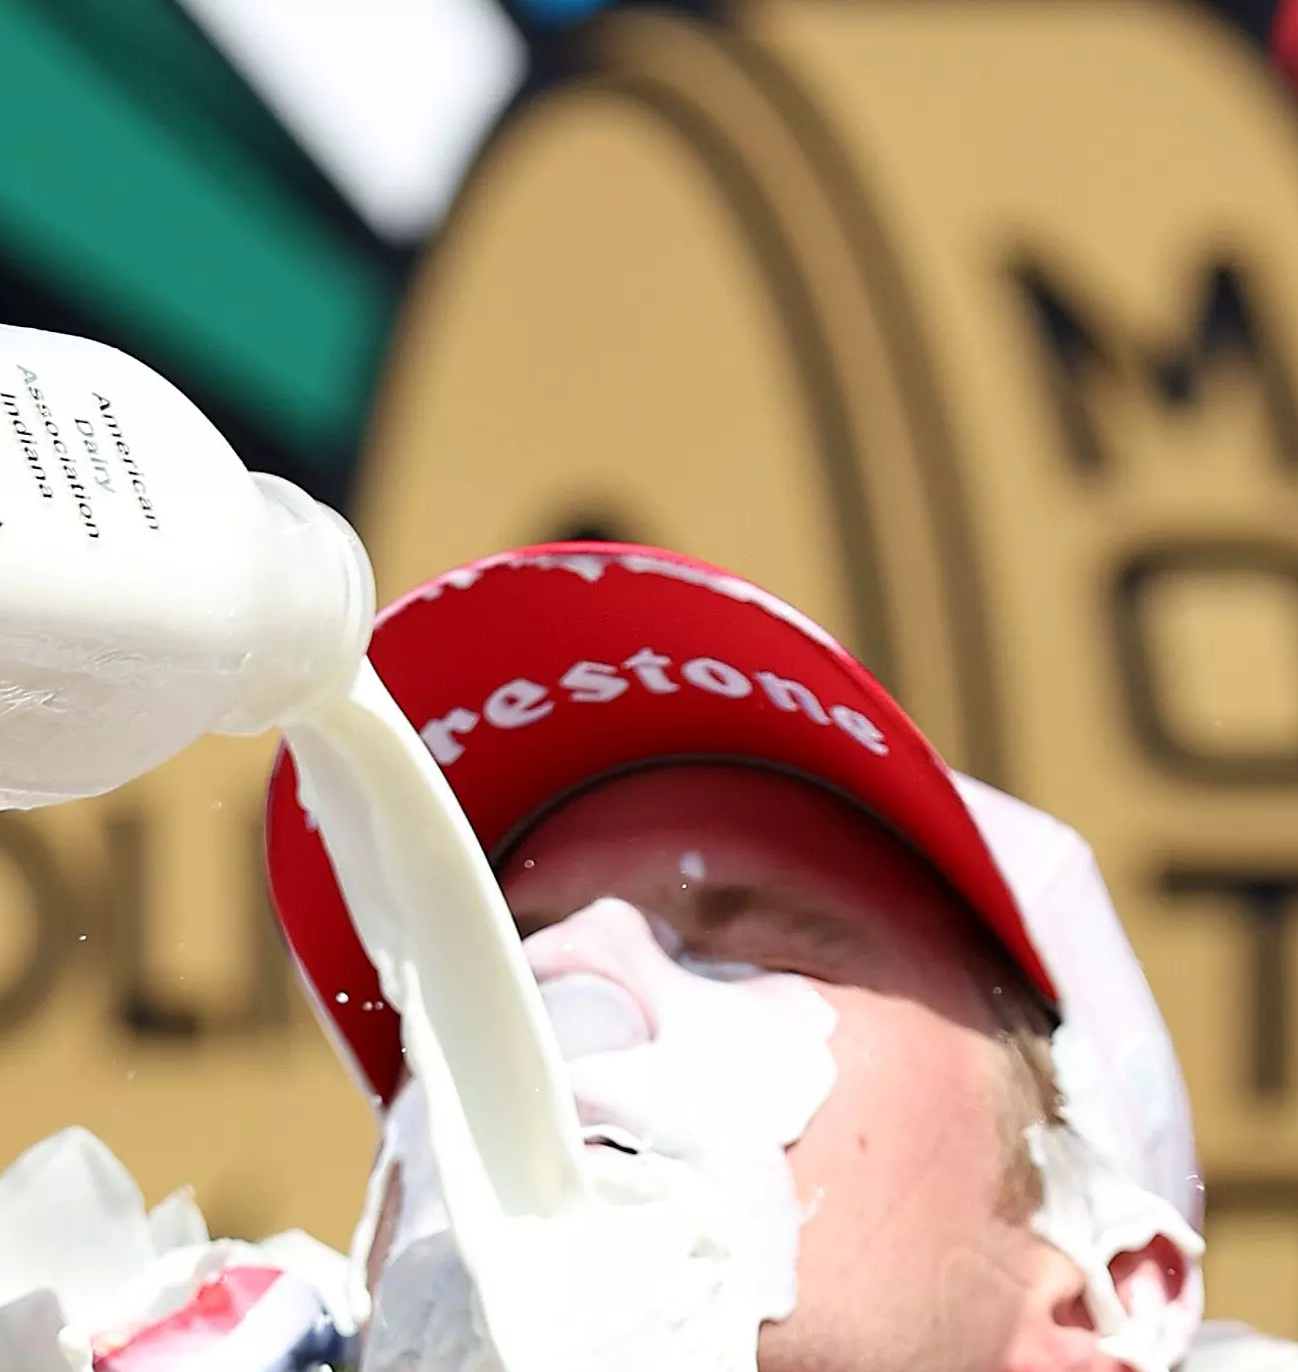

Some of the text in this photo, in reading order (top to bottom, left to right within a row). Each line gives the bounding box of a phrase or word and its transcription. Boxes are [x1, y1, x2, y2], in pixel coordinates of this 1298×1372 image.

[0, 391, 54, 499] Indiana
[16, 364, 99, 538] Association
[75, 417, 116, 493] Dairy
[92, 391, 159, 531] American
[419, 646, 890, 765] restone
